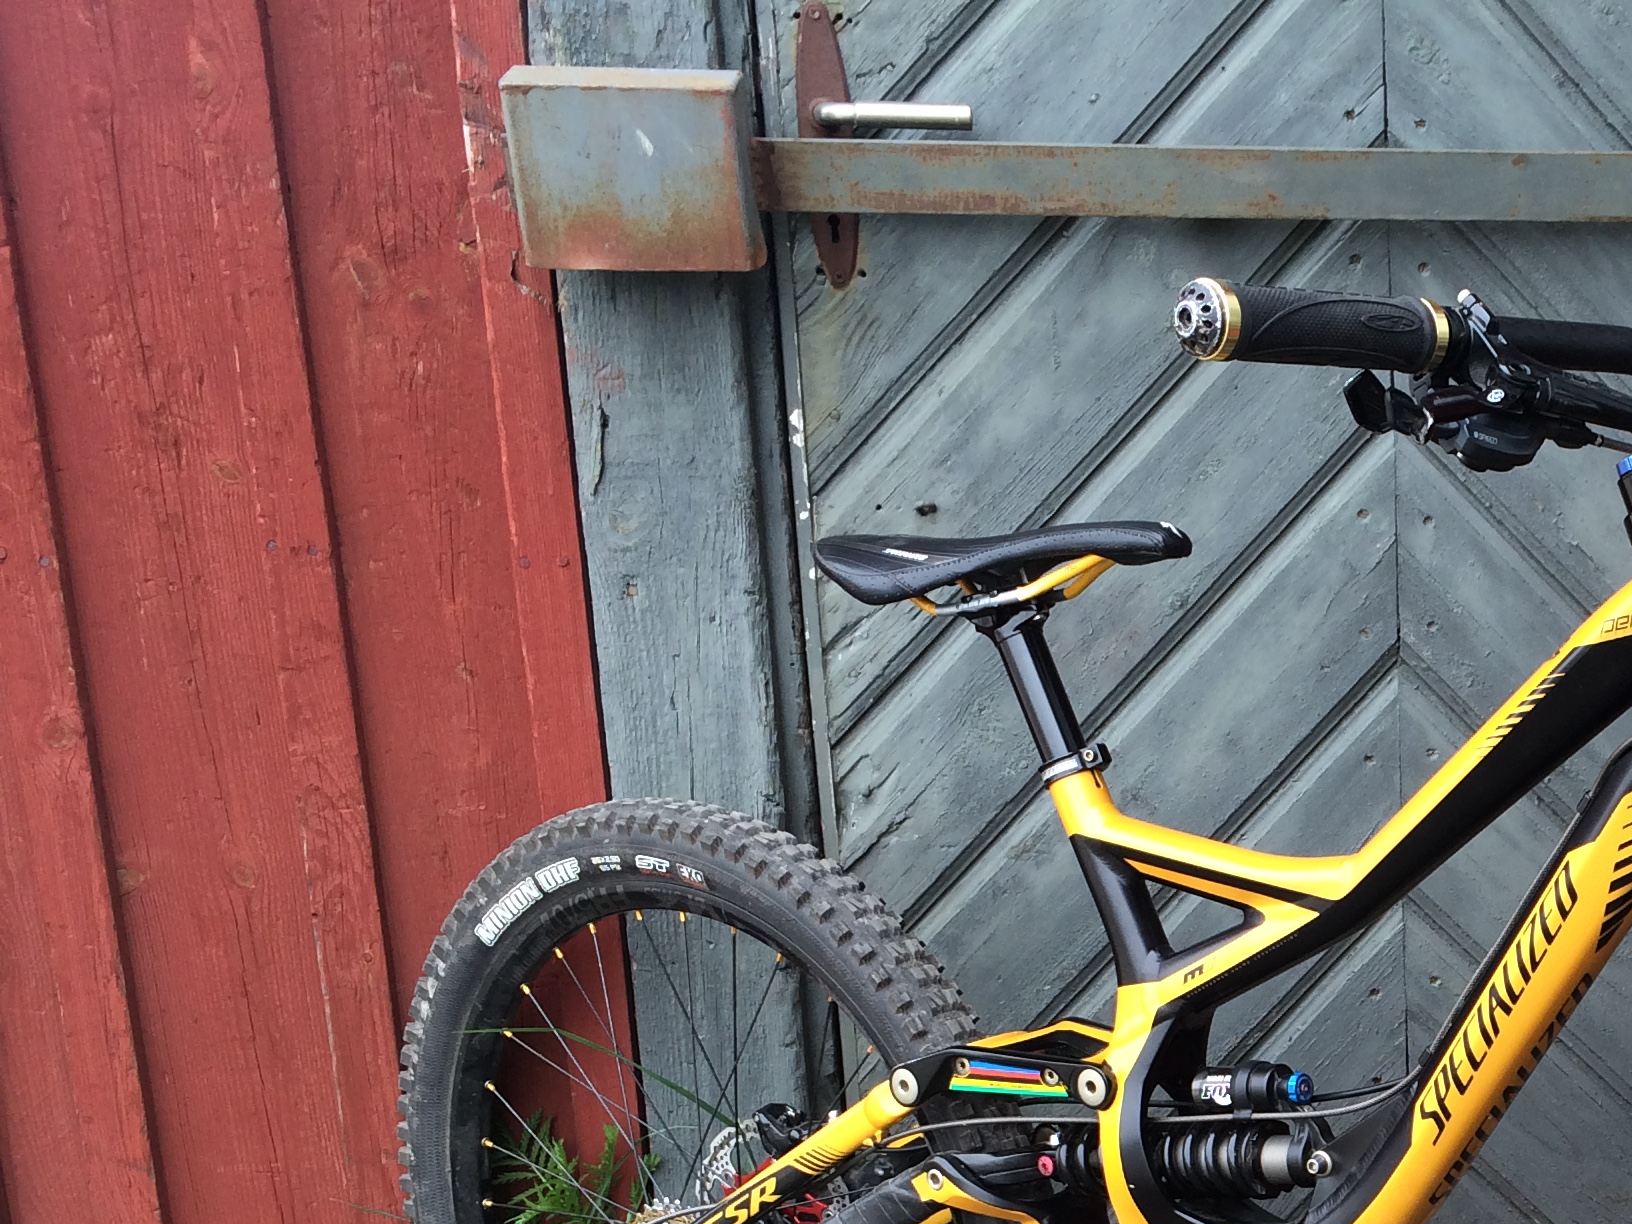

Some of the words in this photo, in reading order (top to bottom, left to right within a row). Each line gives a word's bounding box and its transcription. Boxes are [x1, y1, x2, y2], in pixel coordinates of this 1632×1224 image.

[474, 876, 543, 947] MINION
[534, 857, 581, 893] DHF
[1420, 859, 1579, 1146] SPECIALIZED
